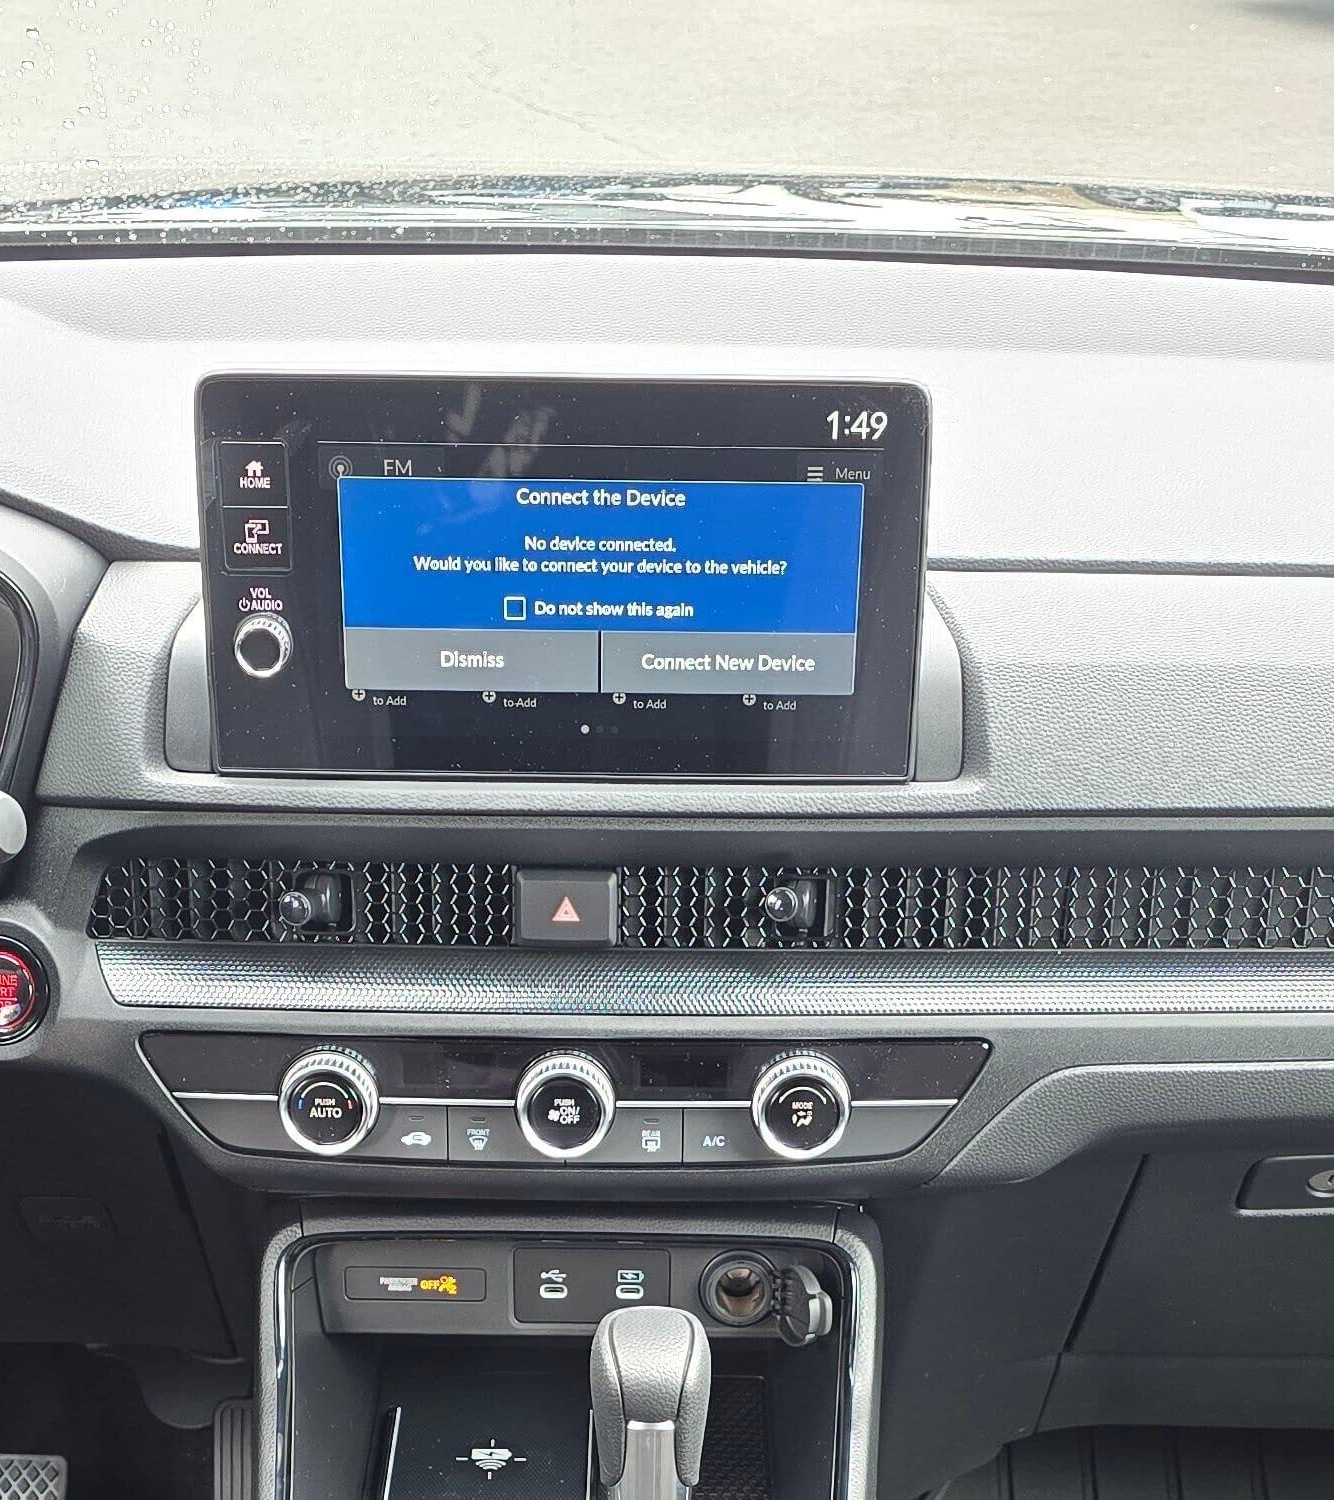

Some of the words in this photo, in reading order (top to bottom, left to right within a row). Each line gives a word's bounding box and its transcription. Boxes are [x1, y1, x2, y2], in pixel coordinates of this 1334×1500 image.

[826, 410, 889, 440] 1:49
[383, 459, 412, 476] FM
[835, 467, 871, 480] Menu
[239, 477, 271, 489] HOME
[516, 487, 588, 505] Connect
[593, 488, 622, 506] the
[626, 489, 686, 507] Device
[233, 543, 283, 555] CONNECT
[524, 536, 546, 551] No
[549, 536, 595, 551] device
[598, 537, 677, 553] connected.
[413, 555, 461, 571] Would
[464, 559, 491, 574] you
[495, 556, 519, 572] like
[522, 558, 537, 572] to
[541, 558, 598, 573] connect
[601, 561, 634, 576] your
[637, 559, 682, 574] device
[685, 561, 701, 575] to
[705, 560, 728, 575] the
[731, 560, 788, 576] vehicle?
[250, 587, 272, 598] VOL
[250, 600, 283, 611] AUDIO
[534, 601, 555, 615] Do
[559, 602, 583, 615] not
[585, 601, 624, 616] show
[627, 602, 653, 616] this
[656, 603, 694, 619] again
[440, 650, 505, 668] Dismiss
[641, 653, 711, 670] Connect
[715, 654, 755, 671] New
[757, 654, 815, 672] Device
[373, 696, 384, 706] to
[386, 695, 407, 706] Add
[503, 698, 515, 707] to
[516, 697, 537, 708] Add
[633, 699, 644, 709] to
[646, 699, 667, 709] Add
[763, 700, 774, 710] to
[775, 700, 796, 711] Add
[314, 1098, 336, 1106] PUSH
[554, 1098, 575, 1106] PUSH
[791, 1101, 813, 1110] MODE
[309, 1107, 342, 1118] AUTO
[560, 1115, 580, 1125] OFF
[467, 1128, 490, 1136] FRONT
[703, 1135, 726, 1147] A/C
[419, 1279, 441, 1290] OFF
